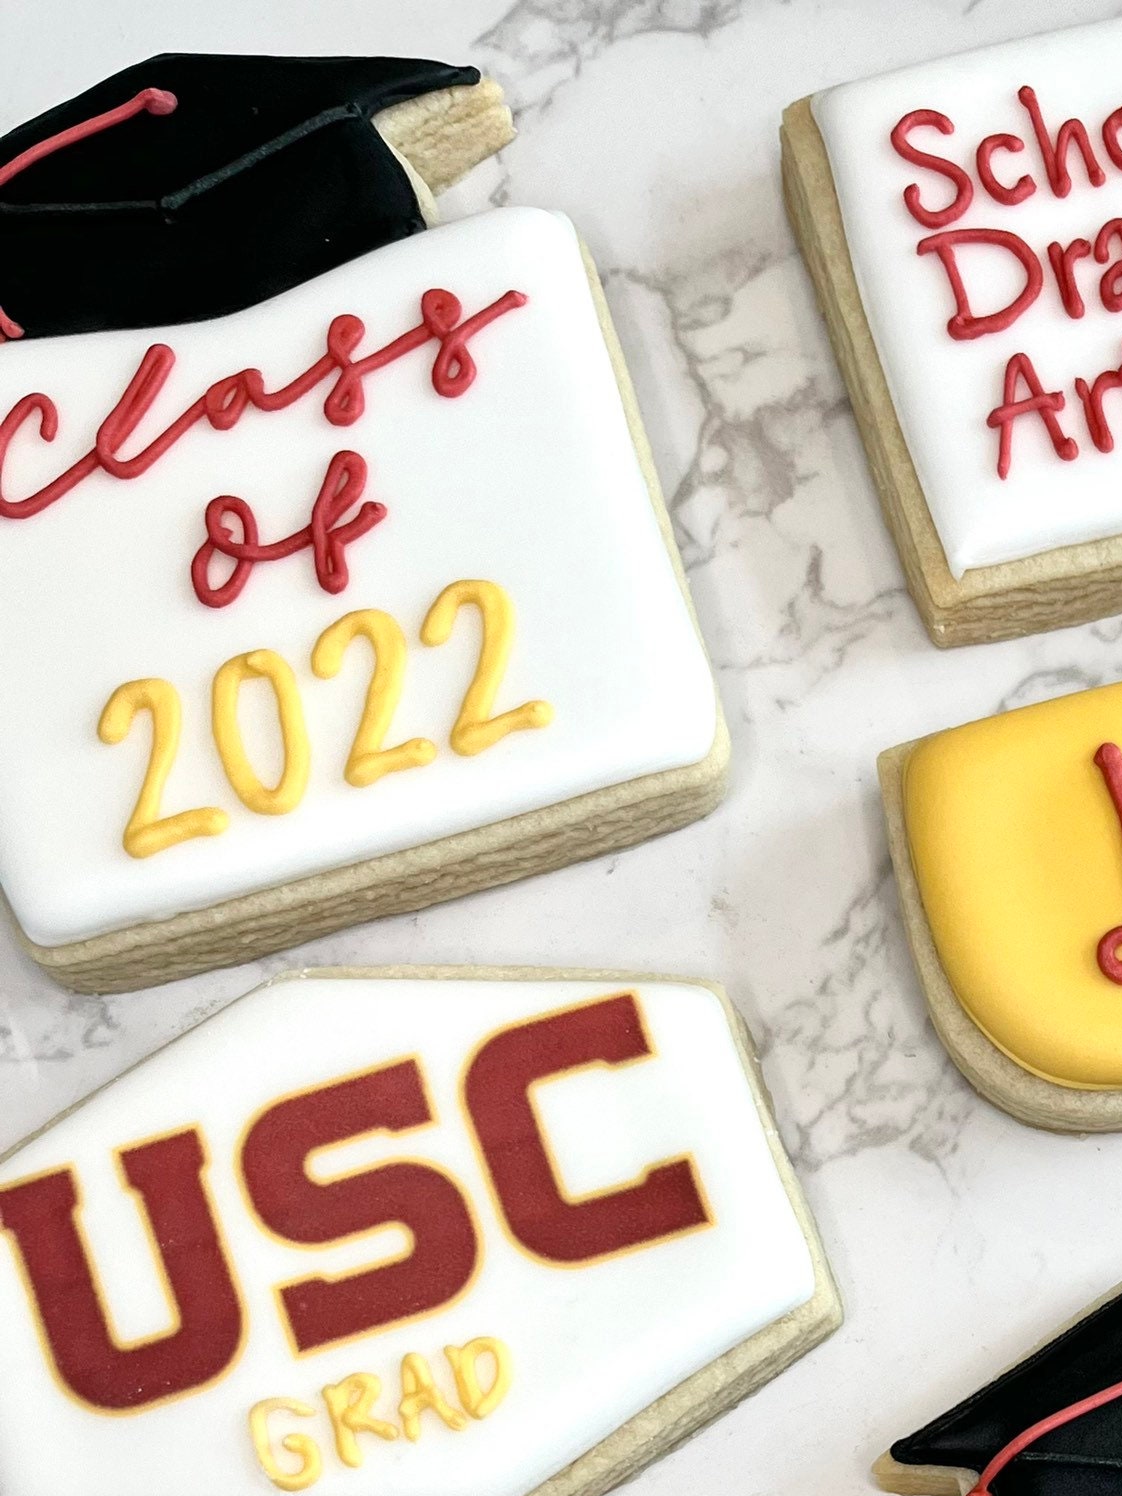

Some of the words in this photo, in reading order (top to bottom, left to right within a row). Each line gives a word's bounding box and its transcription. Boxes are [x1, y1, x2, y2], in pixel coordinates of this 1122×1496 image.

[0, 288, 529, 520] Class
[191, 449, 387, 608] of
[98, 579, 554, 859] 2022
[0, 990, 715, 1418] USC
[247, 1336, 512, 1492] GRAD
